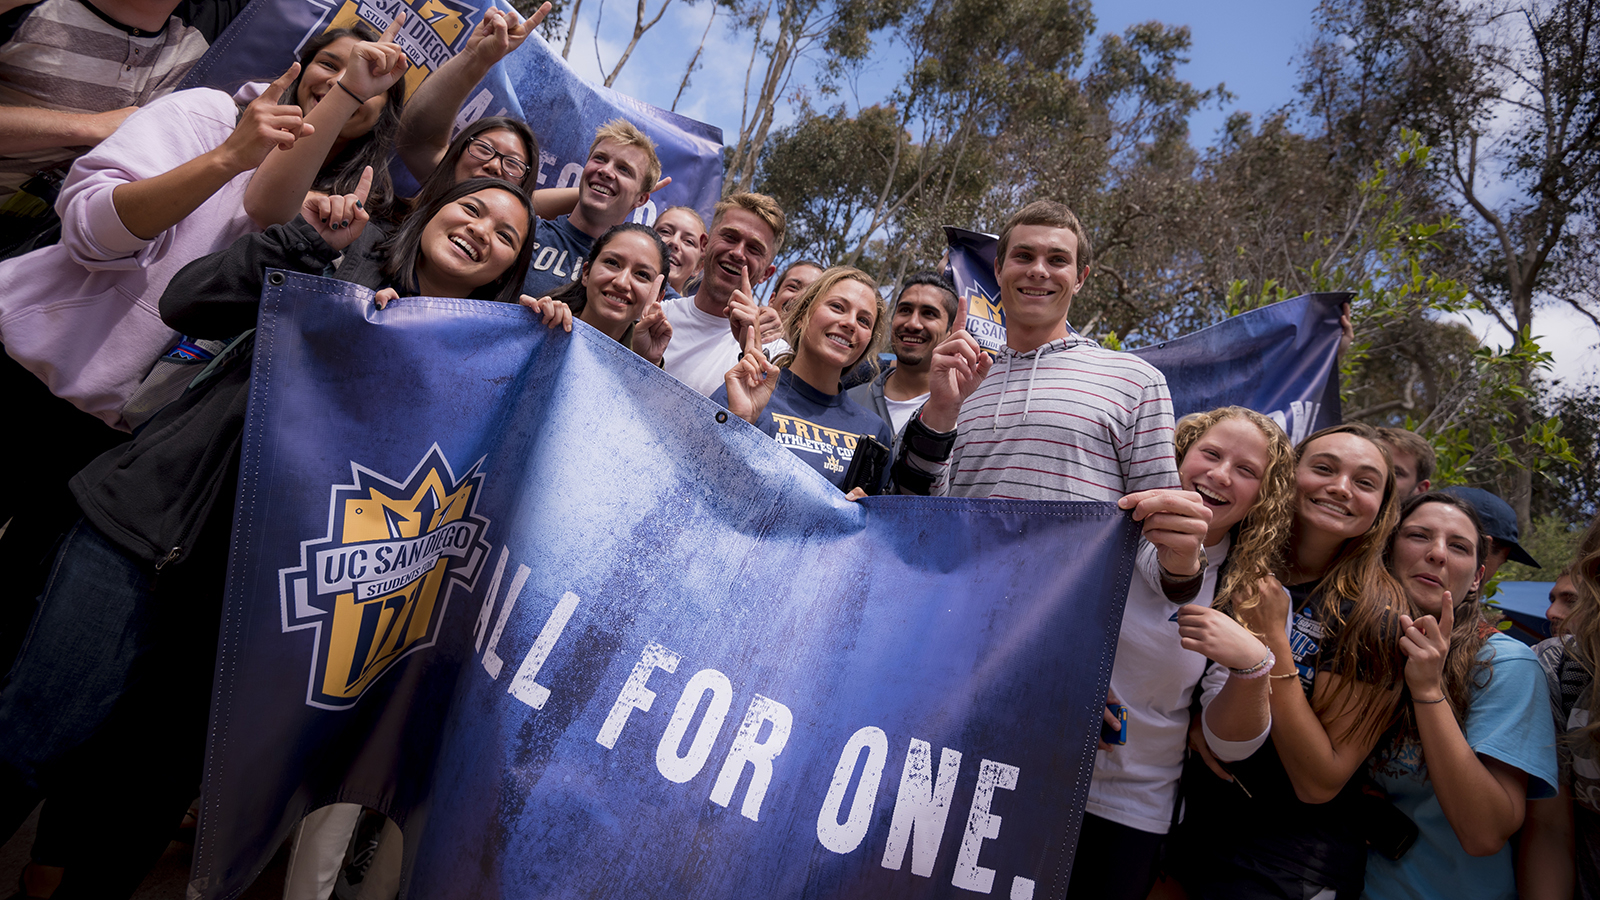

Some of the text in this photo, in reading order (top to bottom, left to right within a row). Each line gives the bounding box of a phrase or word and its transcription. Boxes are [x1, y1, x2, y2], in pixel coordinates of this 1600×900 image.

[364, 9, 421, 62] STUDTS FOR
[772, 415, 858, 450] TRITO
[823, 461, 844, 472] UCSD
[324, 525, 472, 585] UC SAN DIEGO
[366, 559, 435, 597] STUDENTS FOR
[473, 544, 1036, 900] ALL FOR ONE.
